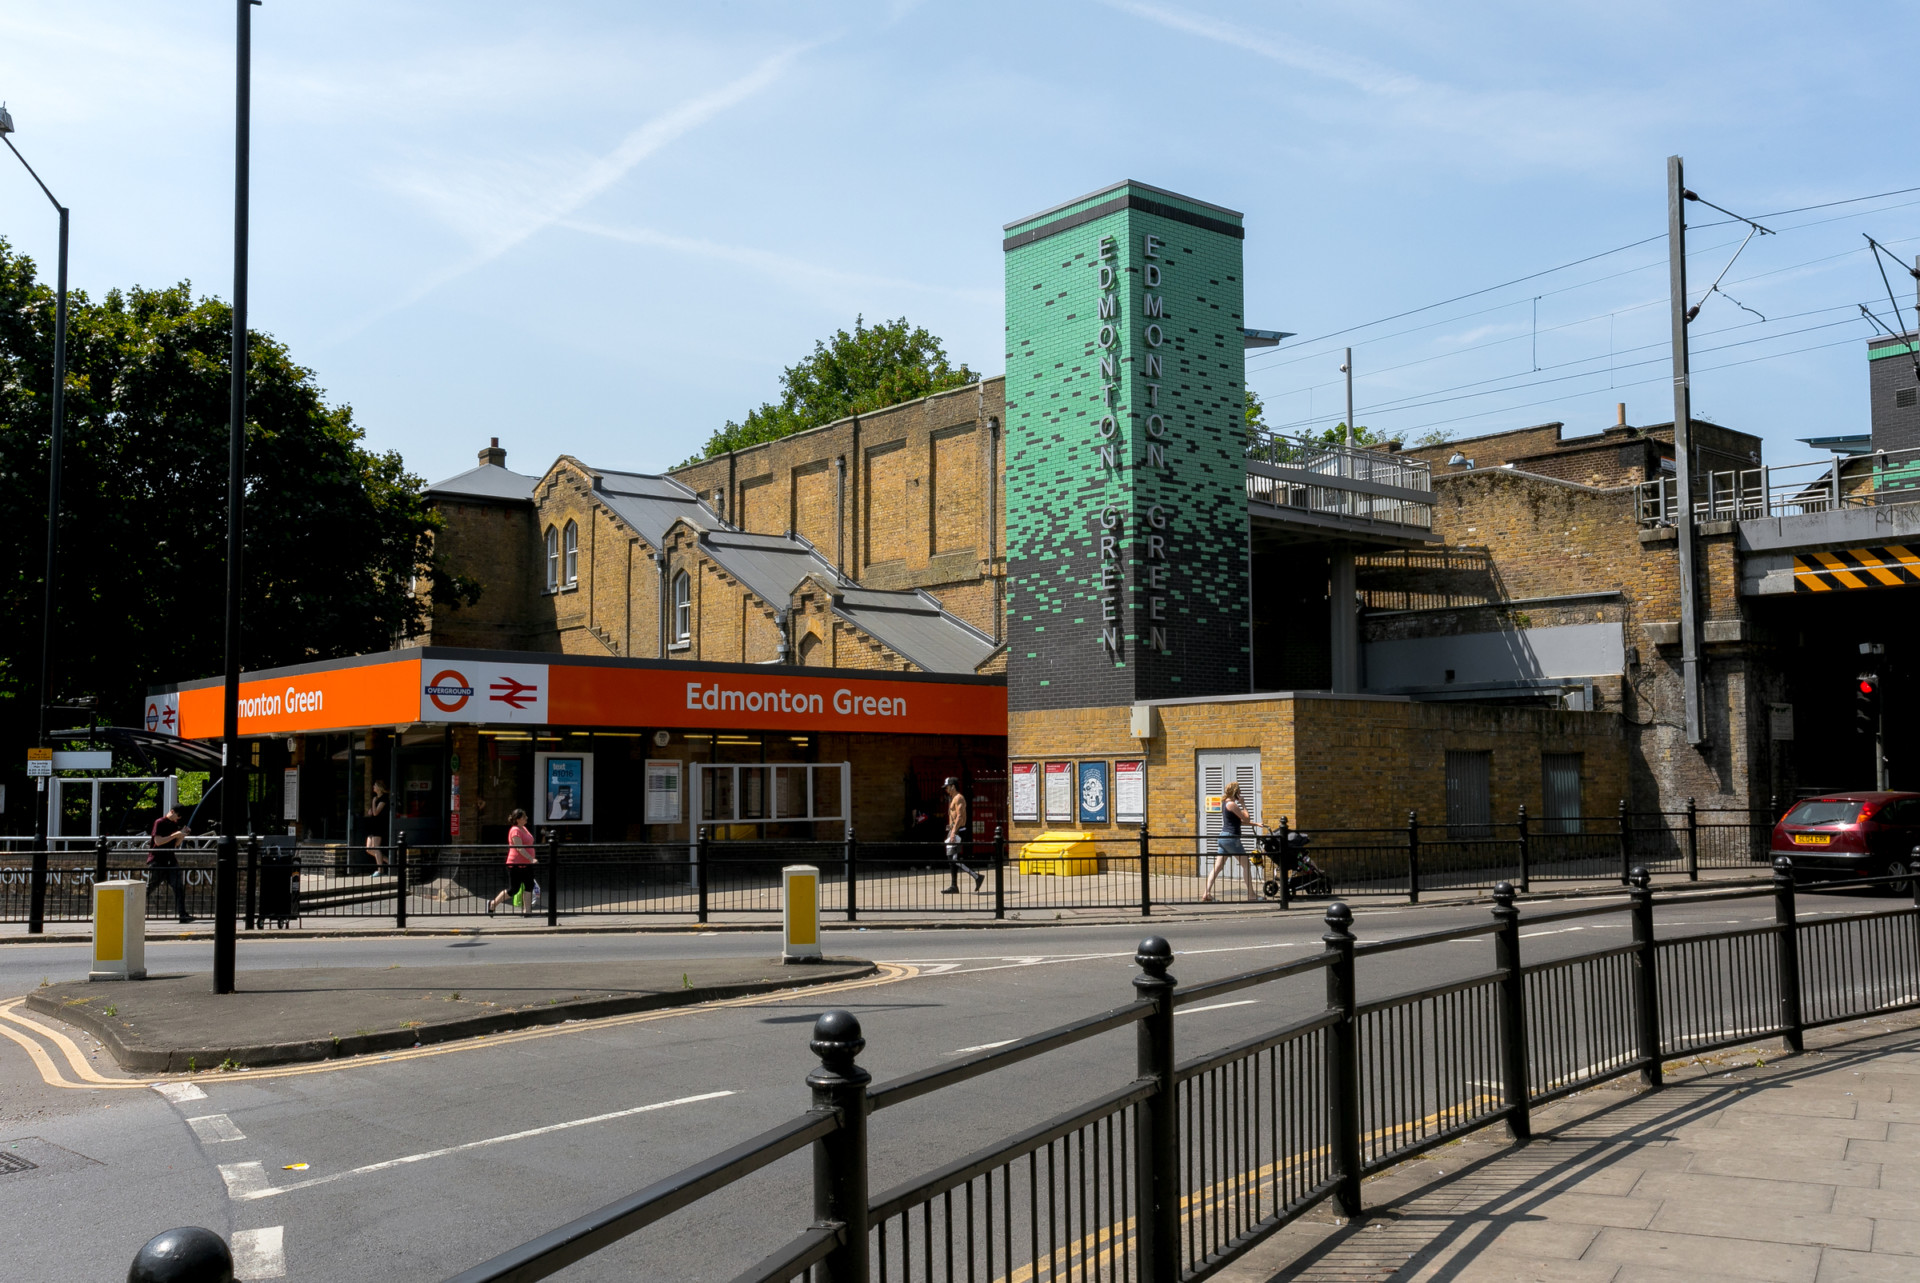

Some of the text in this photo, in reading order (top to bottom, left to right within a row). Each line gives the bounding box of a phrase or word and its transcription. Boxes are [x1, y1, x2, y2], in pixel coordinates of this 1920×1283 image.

[1097, 235, 1117, 652] EDMONTON GREEN
[1144, 234, 1166, 651] EDMONTON GREEN
[237, 686, 323, 718] monton Green
[427, 687, 472, 695] OVERGROUND
[686, 682, 907, 716] Edmonton Green
